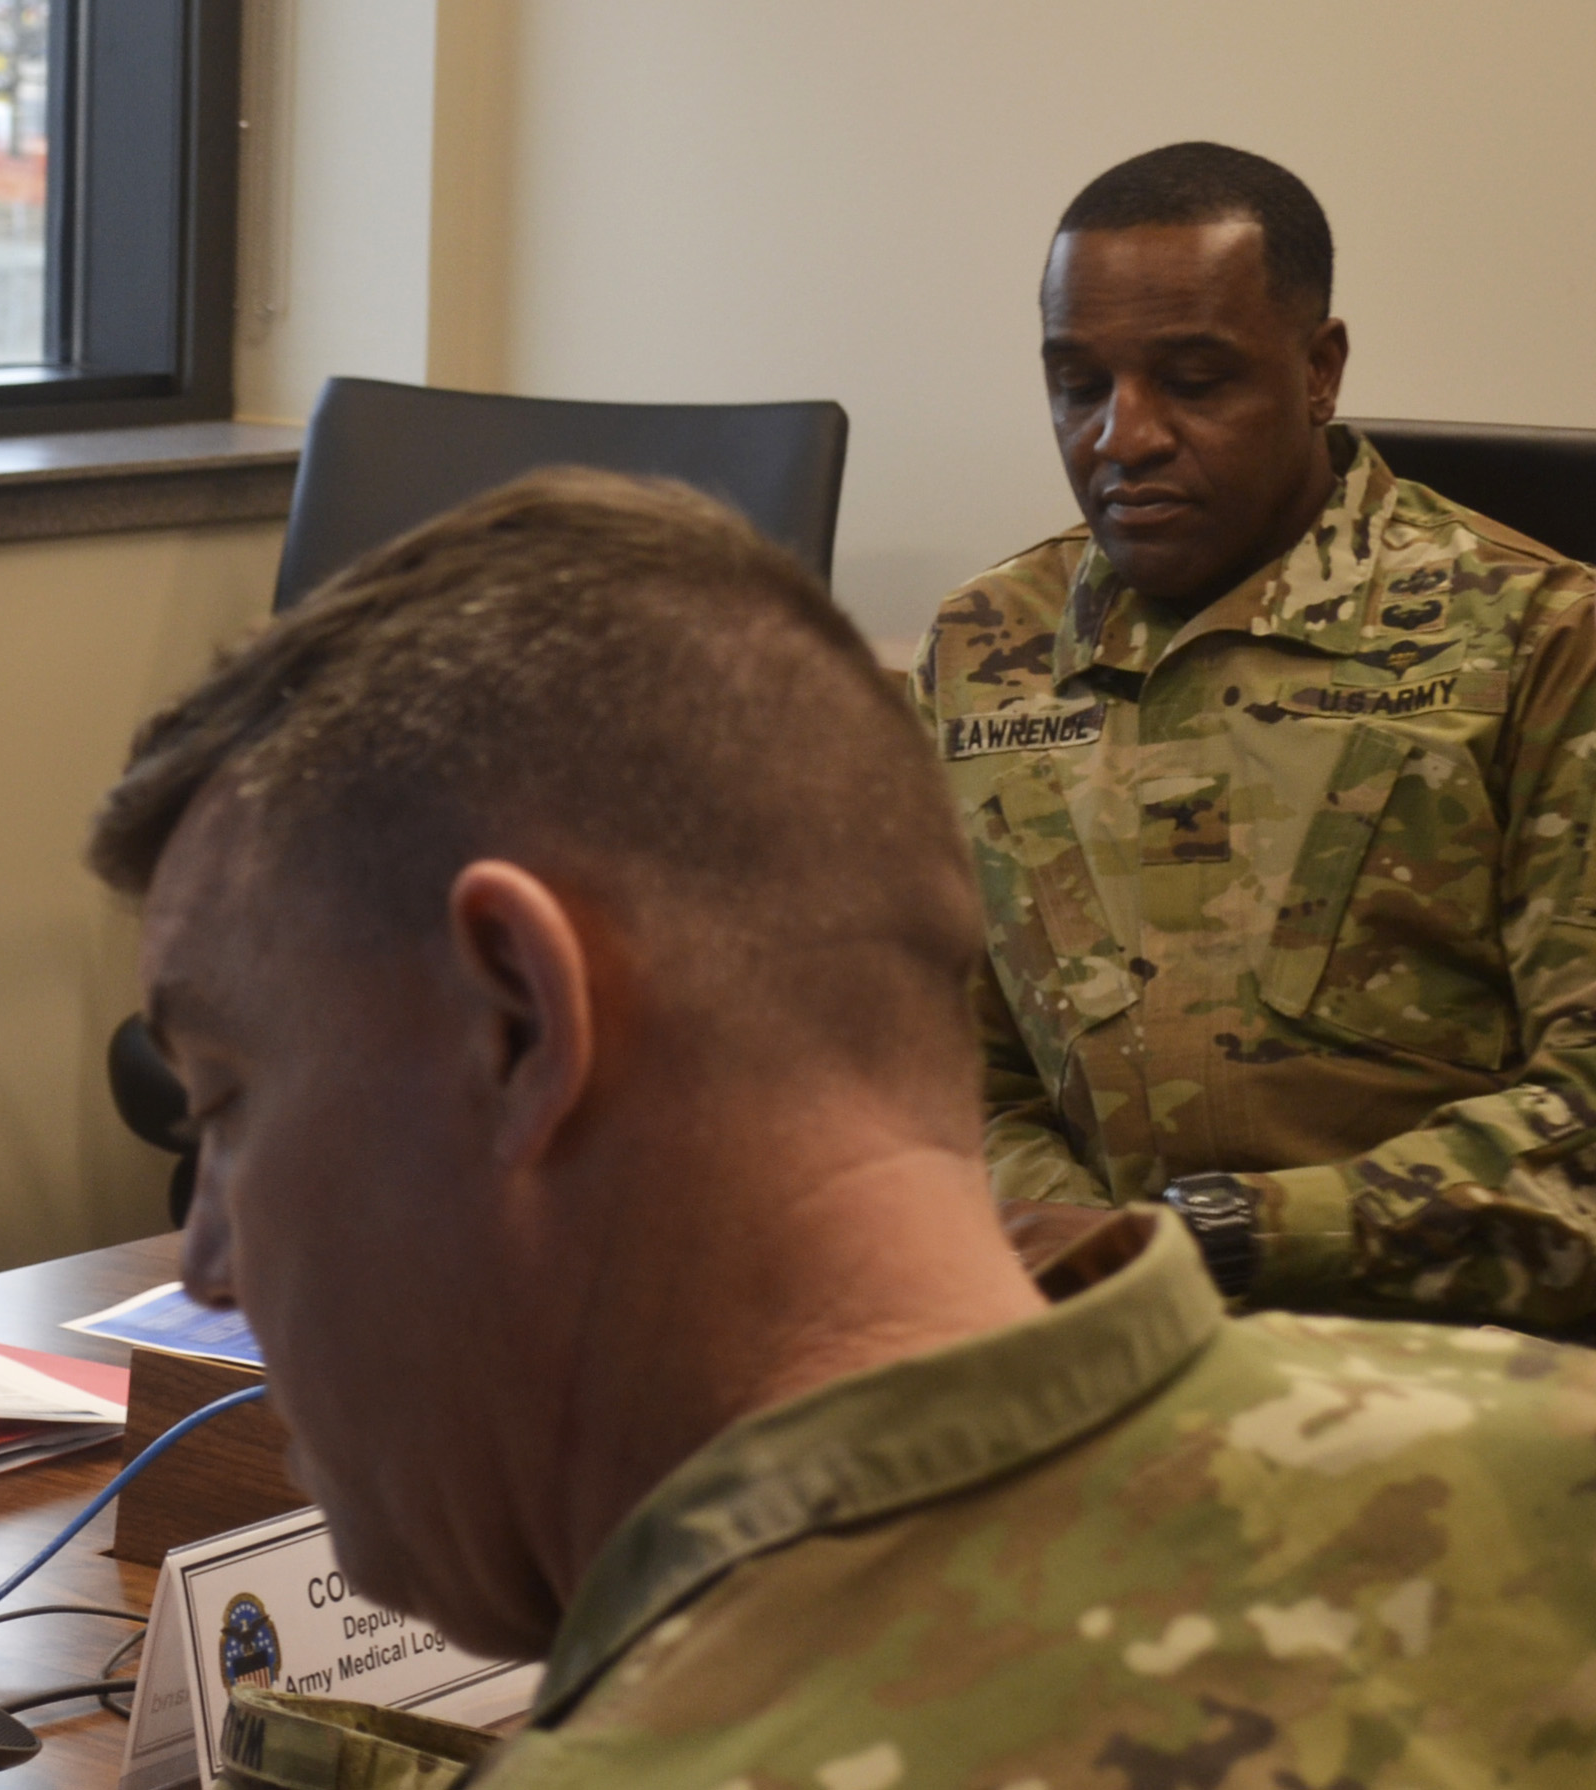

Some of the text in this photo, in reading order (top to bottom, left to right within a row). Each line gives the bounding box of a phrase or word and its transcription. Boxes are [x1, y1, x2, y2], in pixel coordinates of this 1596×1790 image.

[1371, 677, 1458, 715] ARMY
[952, 715, 1089, 752] LAWRENCE
[342, 1608, 406, 1641] Deputy
[285, 1667, 333, 1695] Army
[337, 1635, 408, 1681] Medical
